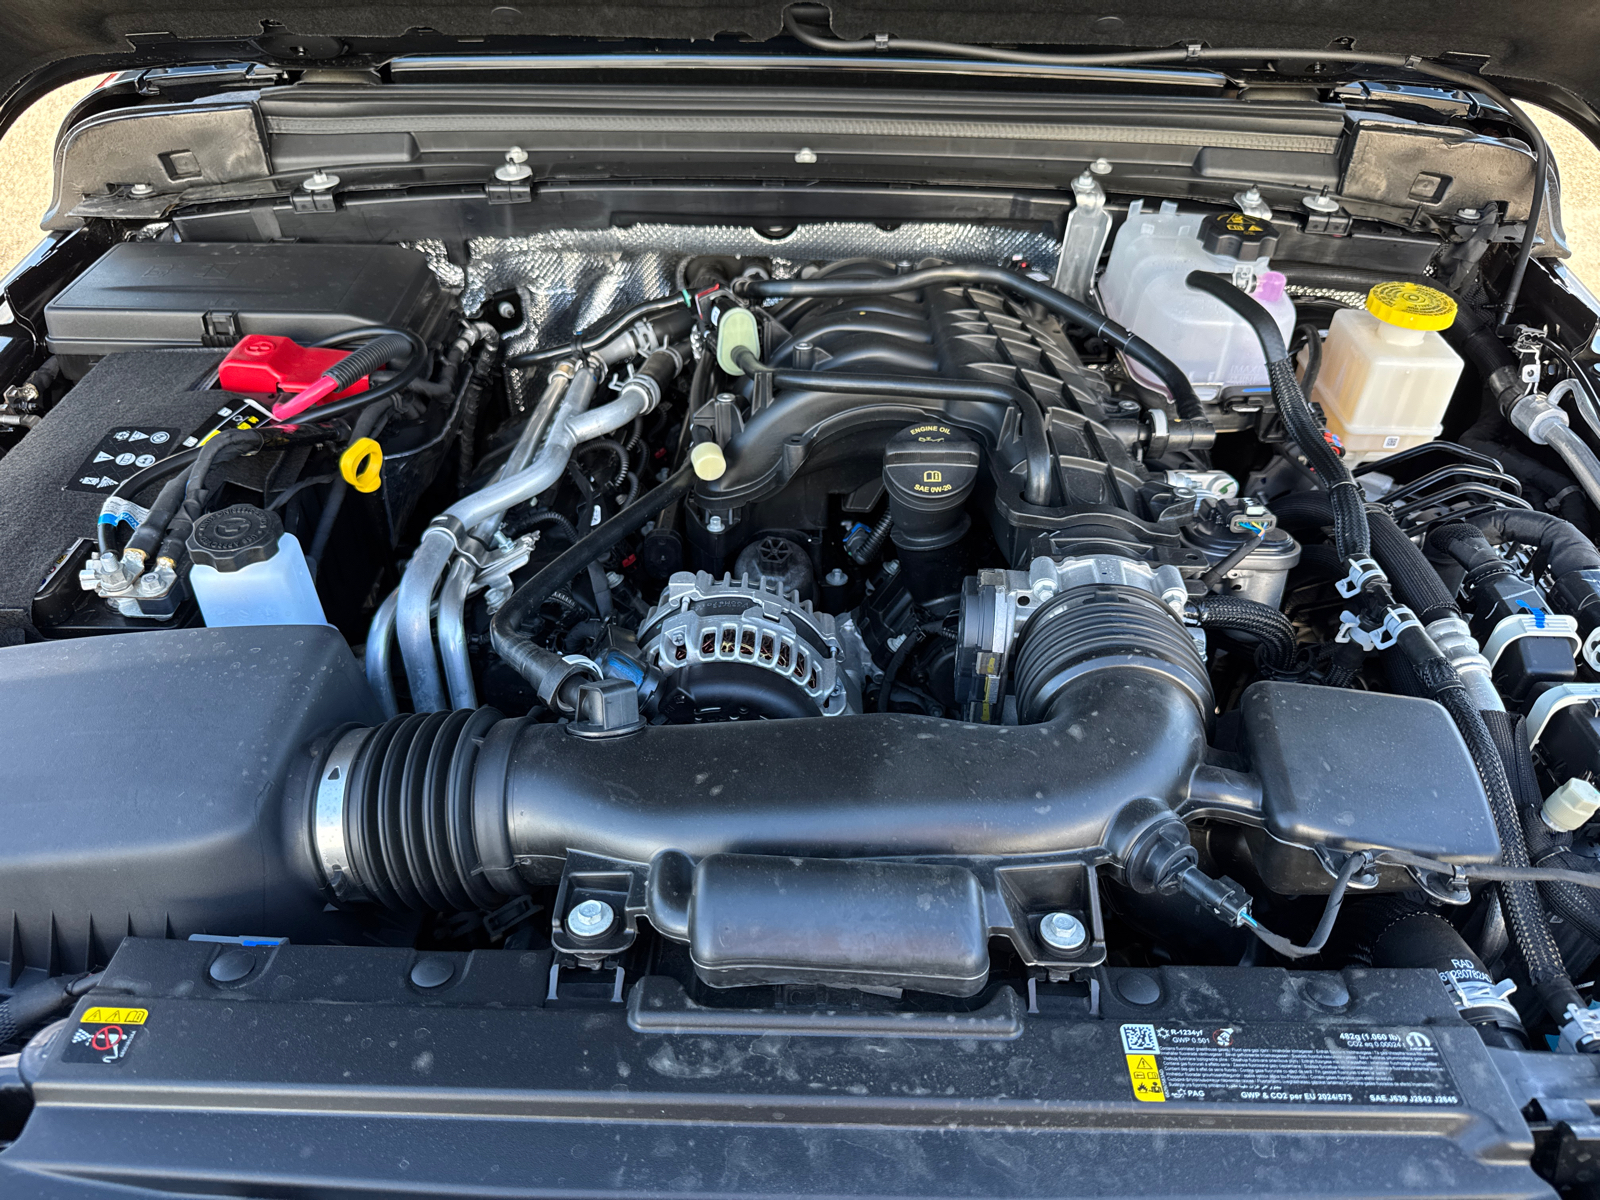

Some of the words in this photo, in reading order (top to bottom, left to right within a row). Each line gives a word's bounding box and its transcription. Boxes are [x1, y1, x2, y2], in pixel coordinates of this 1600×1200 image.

[909, 425, 938, 435] ENGINE
[939, 427, 951, 435] OIL
[914, 484, 930, 492] SAE
[930, 484, 952, 493] 0W-20
[1451, 959, 1475, 969] RAD
[1438, 969, 1493, 984] 6280782AD
[1170, 1029, 1203, 1038] R-1234yf
[1346, 1040, 1364, 1048] CO2
[1187, 1090, 1206, 1098] PAG
[1240, 1091, 1260, 1099] GWP
[1270, 1092, 1288, 1100] CO2
[1289, 1093, 1302, 1102] per
[1303, 1093, 1317, 1101] EU
[1369, 1094, 1388, 1102] SAE
